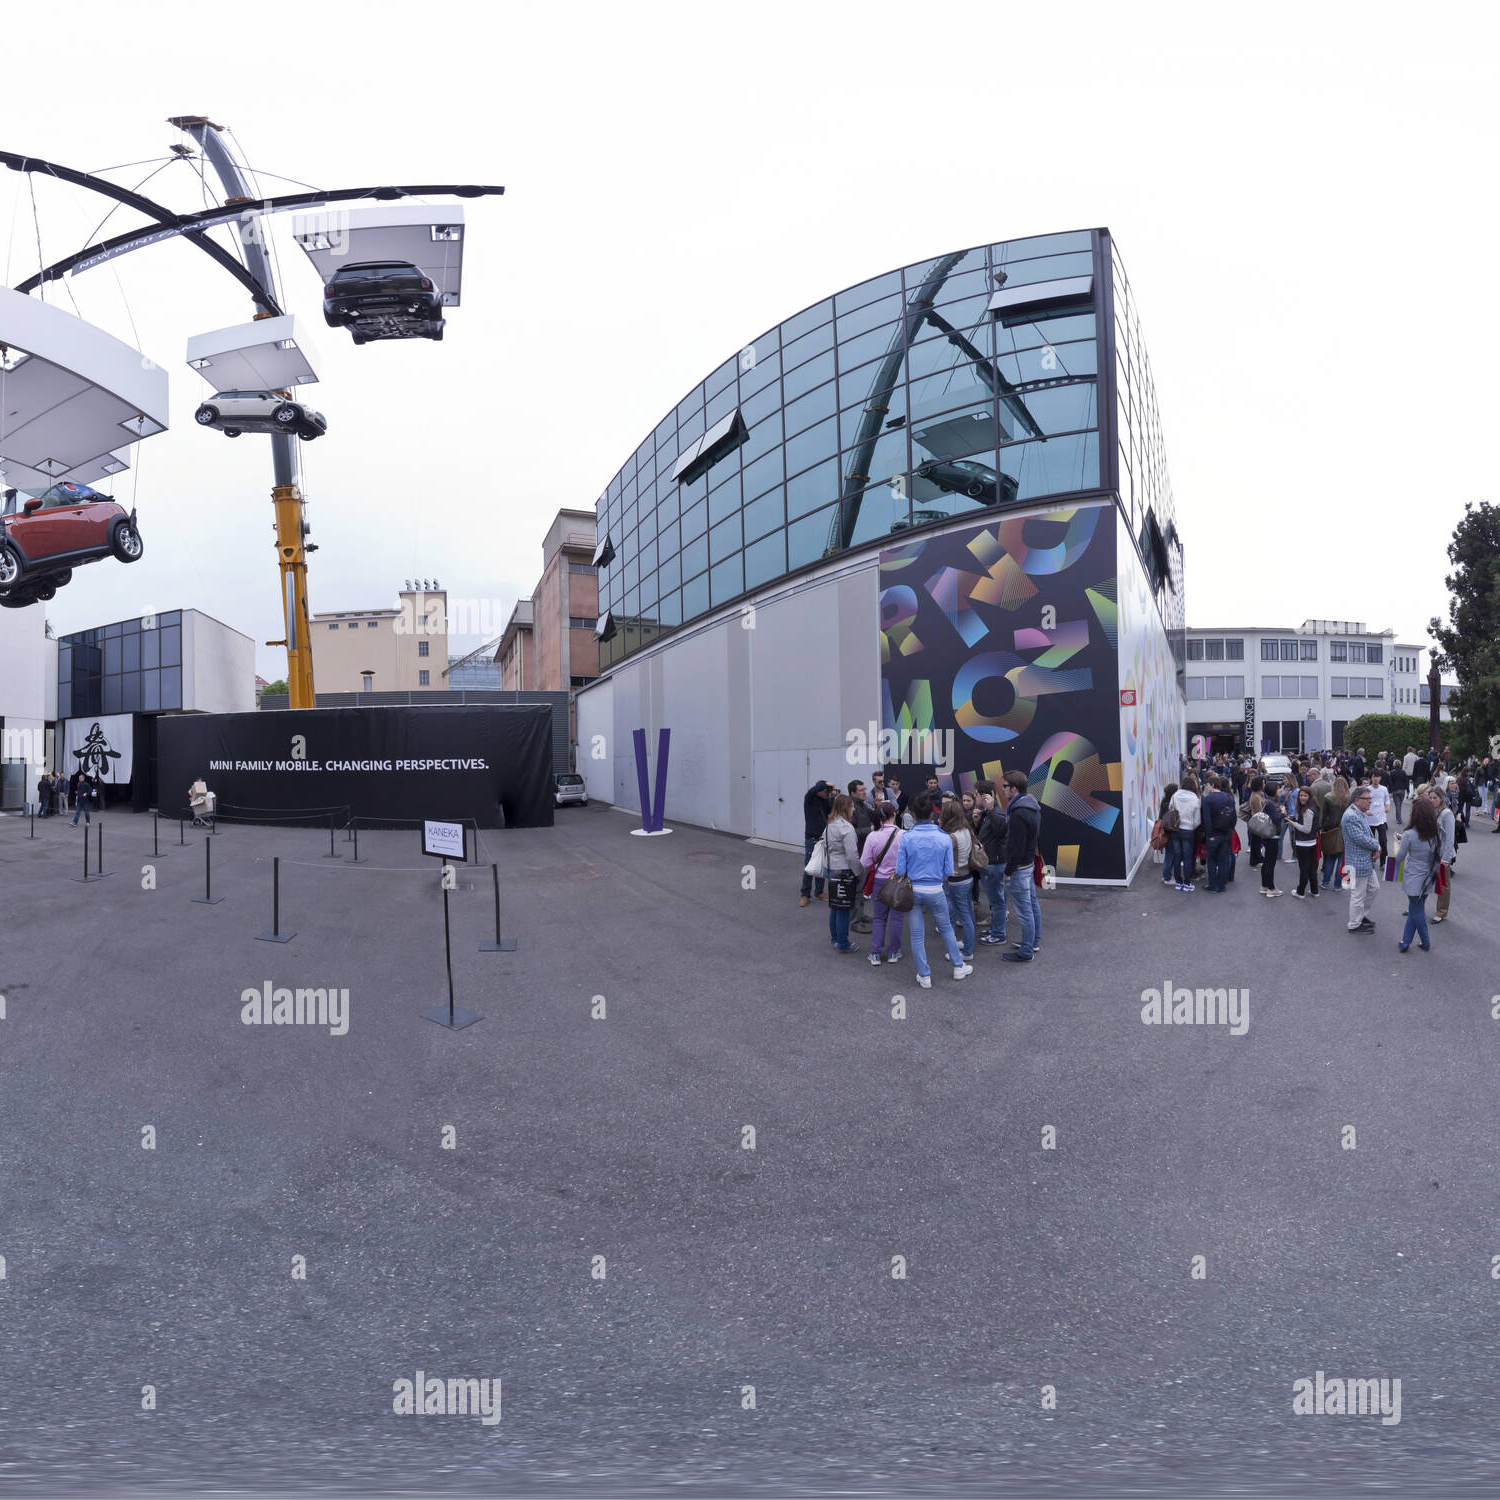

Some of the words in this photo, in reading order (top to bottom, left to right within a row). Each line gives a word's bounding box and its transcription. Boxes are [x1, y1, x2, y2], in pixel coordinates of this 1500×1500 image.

[1245, 698, 1254, 748] ENTRANCE
[209, 760, 233, 770] MINI
[235, 760, 273, 770] FAMILY
[275, 760, 323, 771] MOBILE.
[325, 760, 393, 771] CHANGING
[395, 758, 490, 771] PERSPECTIVES.
[428, 827, 459, 838] KANEKA
